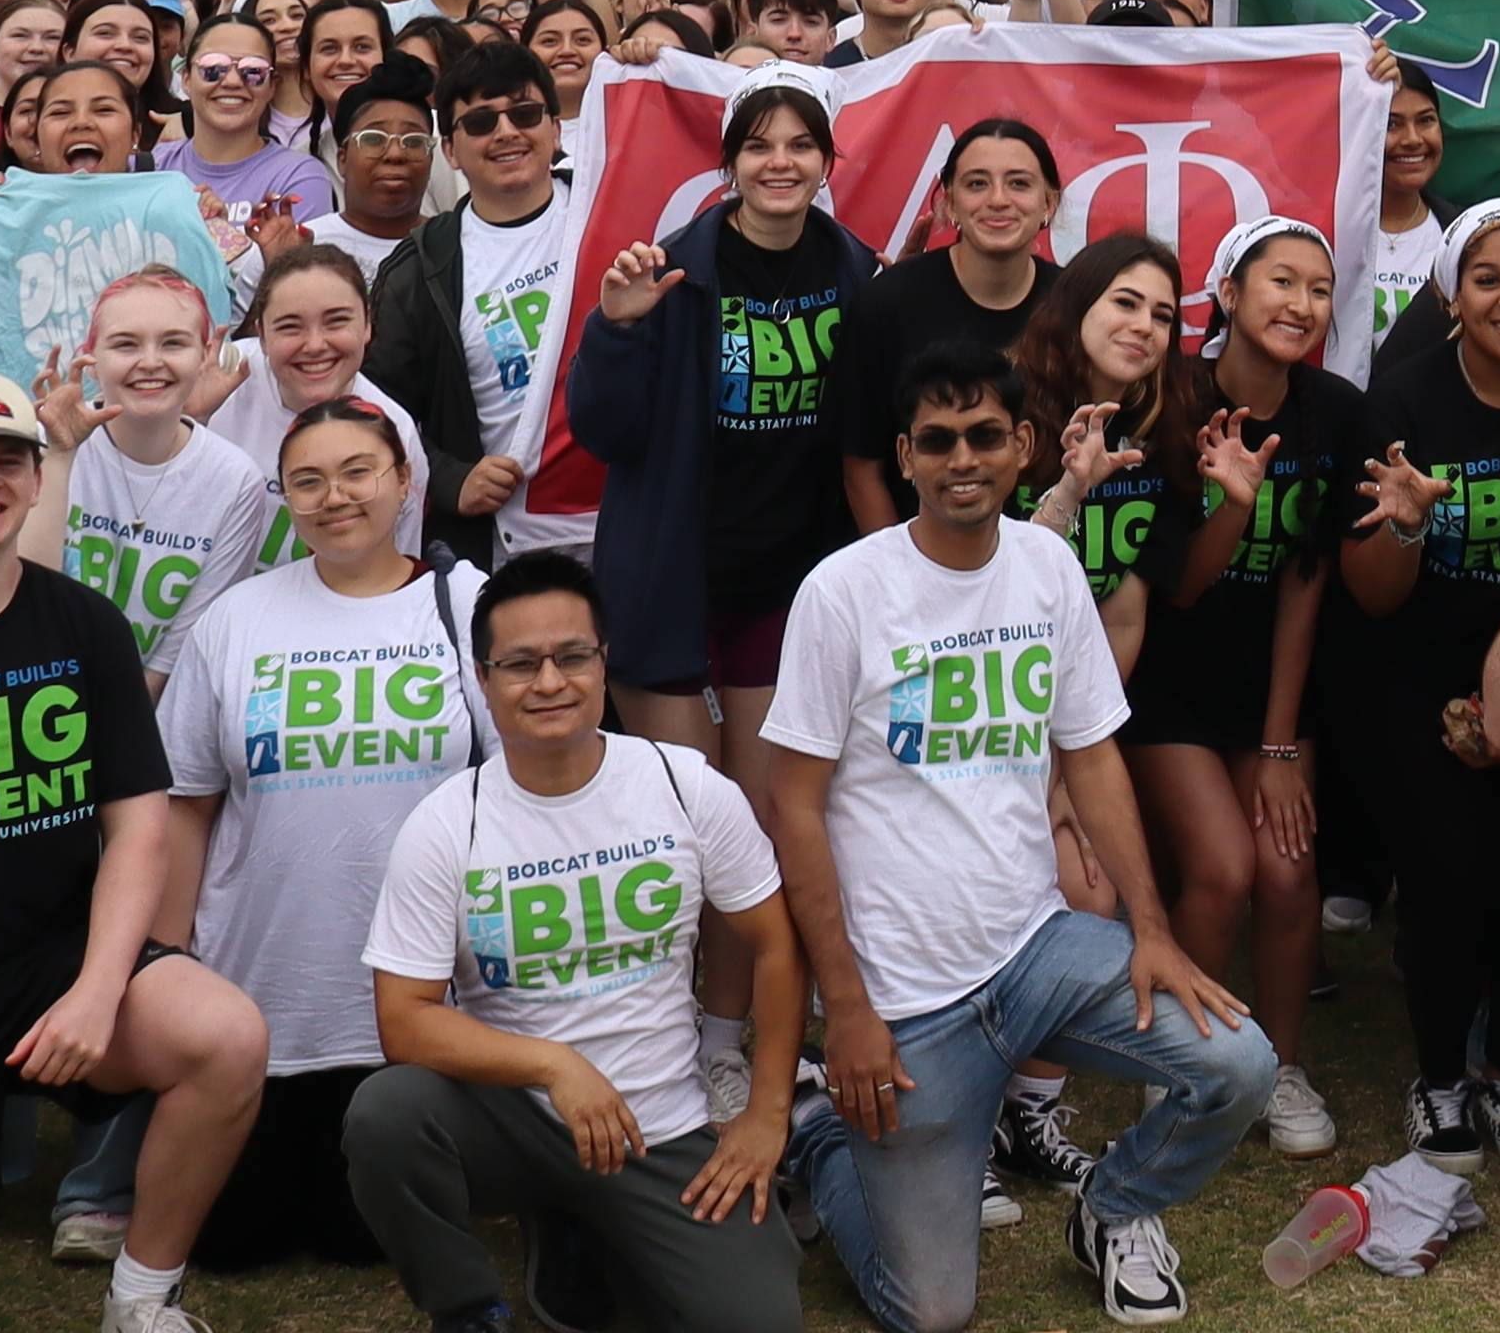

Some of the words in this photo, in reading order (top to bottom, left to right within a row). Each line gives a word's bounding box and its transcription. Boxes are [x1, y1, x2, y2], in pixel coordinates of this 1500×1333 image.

[505, 260, 560, 294] BOBCAT
[751, 377, 826, 414] EVE
[81, 513, 138, 541] BOBCAT
[142, 528, 213, 553] BUILD'S
[79, 535, 201, 620] BIG
[291, 649, 371, 664] BOBCAT
[376, 643, 445, 661] BUILD'S
[930, 628, 995, 653] BOBCAT
[999, 620, 1054, 642] BUILD'S
[5, 658, 80, 687] BUILD'S
[285, 662, 445, 728] BIG
[930, 643, 1053, 724] BIG
[284, 725, 450, 771] EVENT
[926, 718, 1050, 764] EVEN
[507, 852, 590, 881] BOBCAT
[596, 833, 676, 865] BUILD'S
[509, 860, 683, 958] BIG
[515, 928, 681, 989] EVENT
